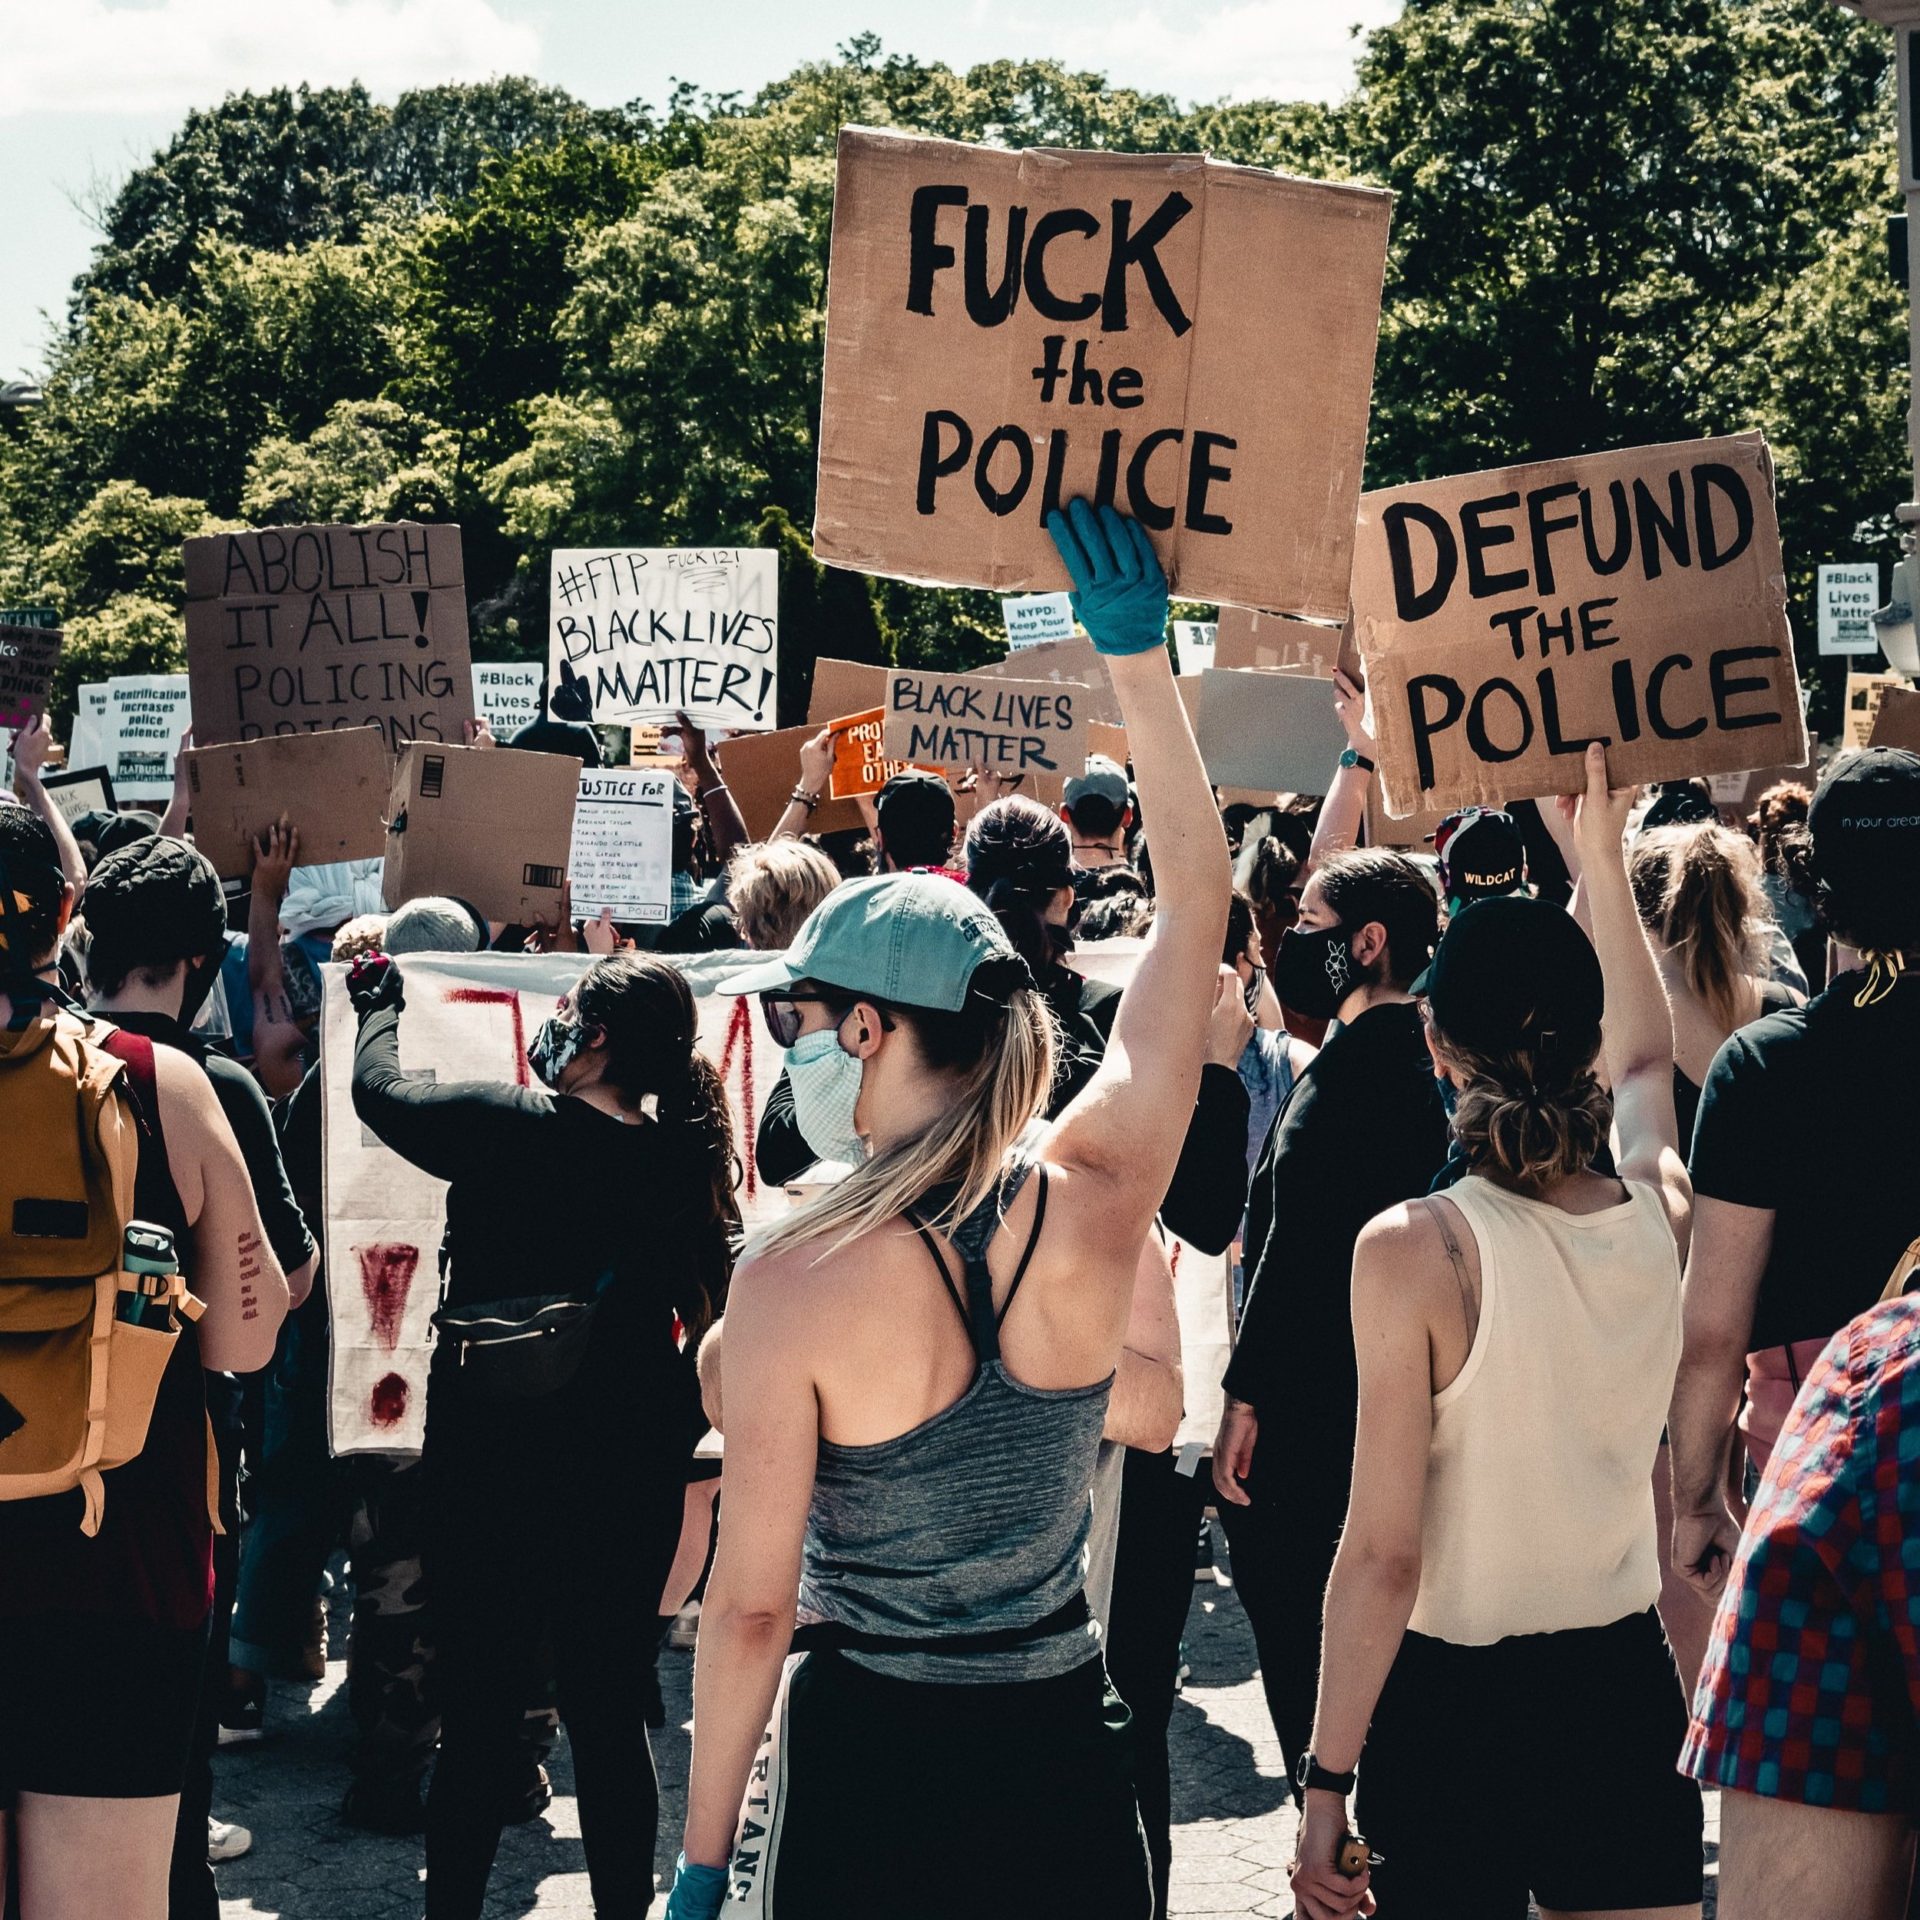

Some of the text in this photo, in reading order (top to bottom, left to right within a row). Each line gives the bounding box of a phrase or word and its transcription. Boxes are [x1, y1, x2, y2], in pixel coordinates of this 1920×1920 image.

[906, 185, 1193, 337] FUCK
[1032, 336, 1144, 408] the
[917, 410, 1237, 535] POLICE
[1382, 463, 1754, 622] DEFUND
[223, 529, 432, 597] ABOLISH
[667, 554, 707, 569] FUCK
[558, 553, 648, 606] #FTP
[1826, 572, 1873, 584] #Black
[1829, 591, 1870, 603] Lives
[226, 591, 429, 650] IT ALL!
[1017, 606, 1056, 618] NYPD:
[1831, 607, 1875, 618] Matte
[1009, 617, 1065, 631] Keep Your
[1490, 597, 1620, 659] THE
[557, 609, 775, 662] BLACK LIVES
[480, 672, 534, 686] #Black
[596, 657, 776, 721] MATTER!
[114, 688, 186, 701] Gentrification
[234, 660, 455, 721] POLICING
[483, 692, 530, 708] Lives
[121, 702, 175, 713] increases
[893, 678, 1073, 730] BLACK LIVES
[128, 714, 163, 726] police
[1407, 646, 1782, 791] POLICE
[863, 741, 884, 762] EA
[908, 724, 1057, 770] MATTER
[1842, 817, 1852, 828] in
[1855, 817, 1881, 830] your
[1464, 867, 1516, 886] WILDCAT
[628, 906, 664, 917] POLICE
